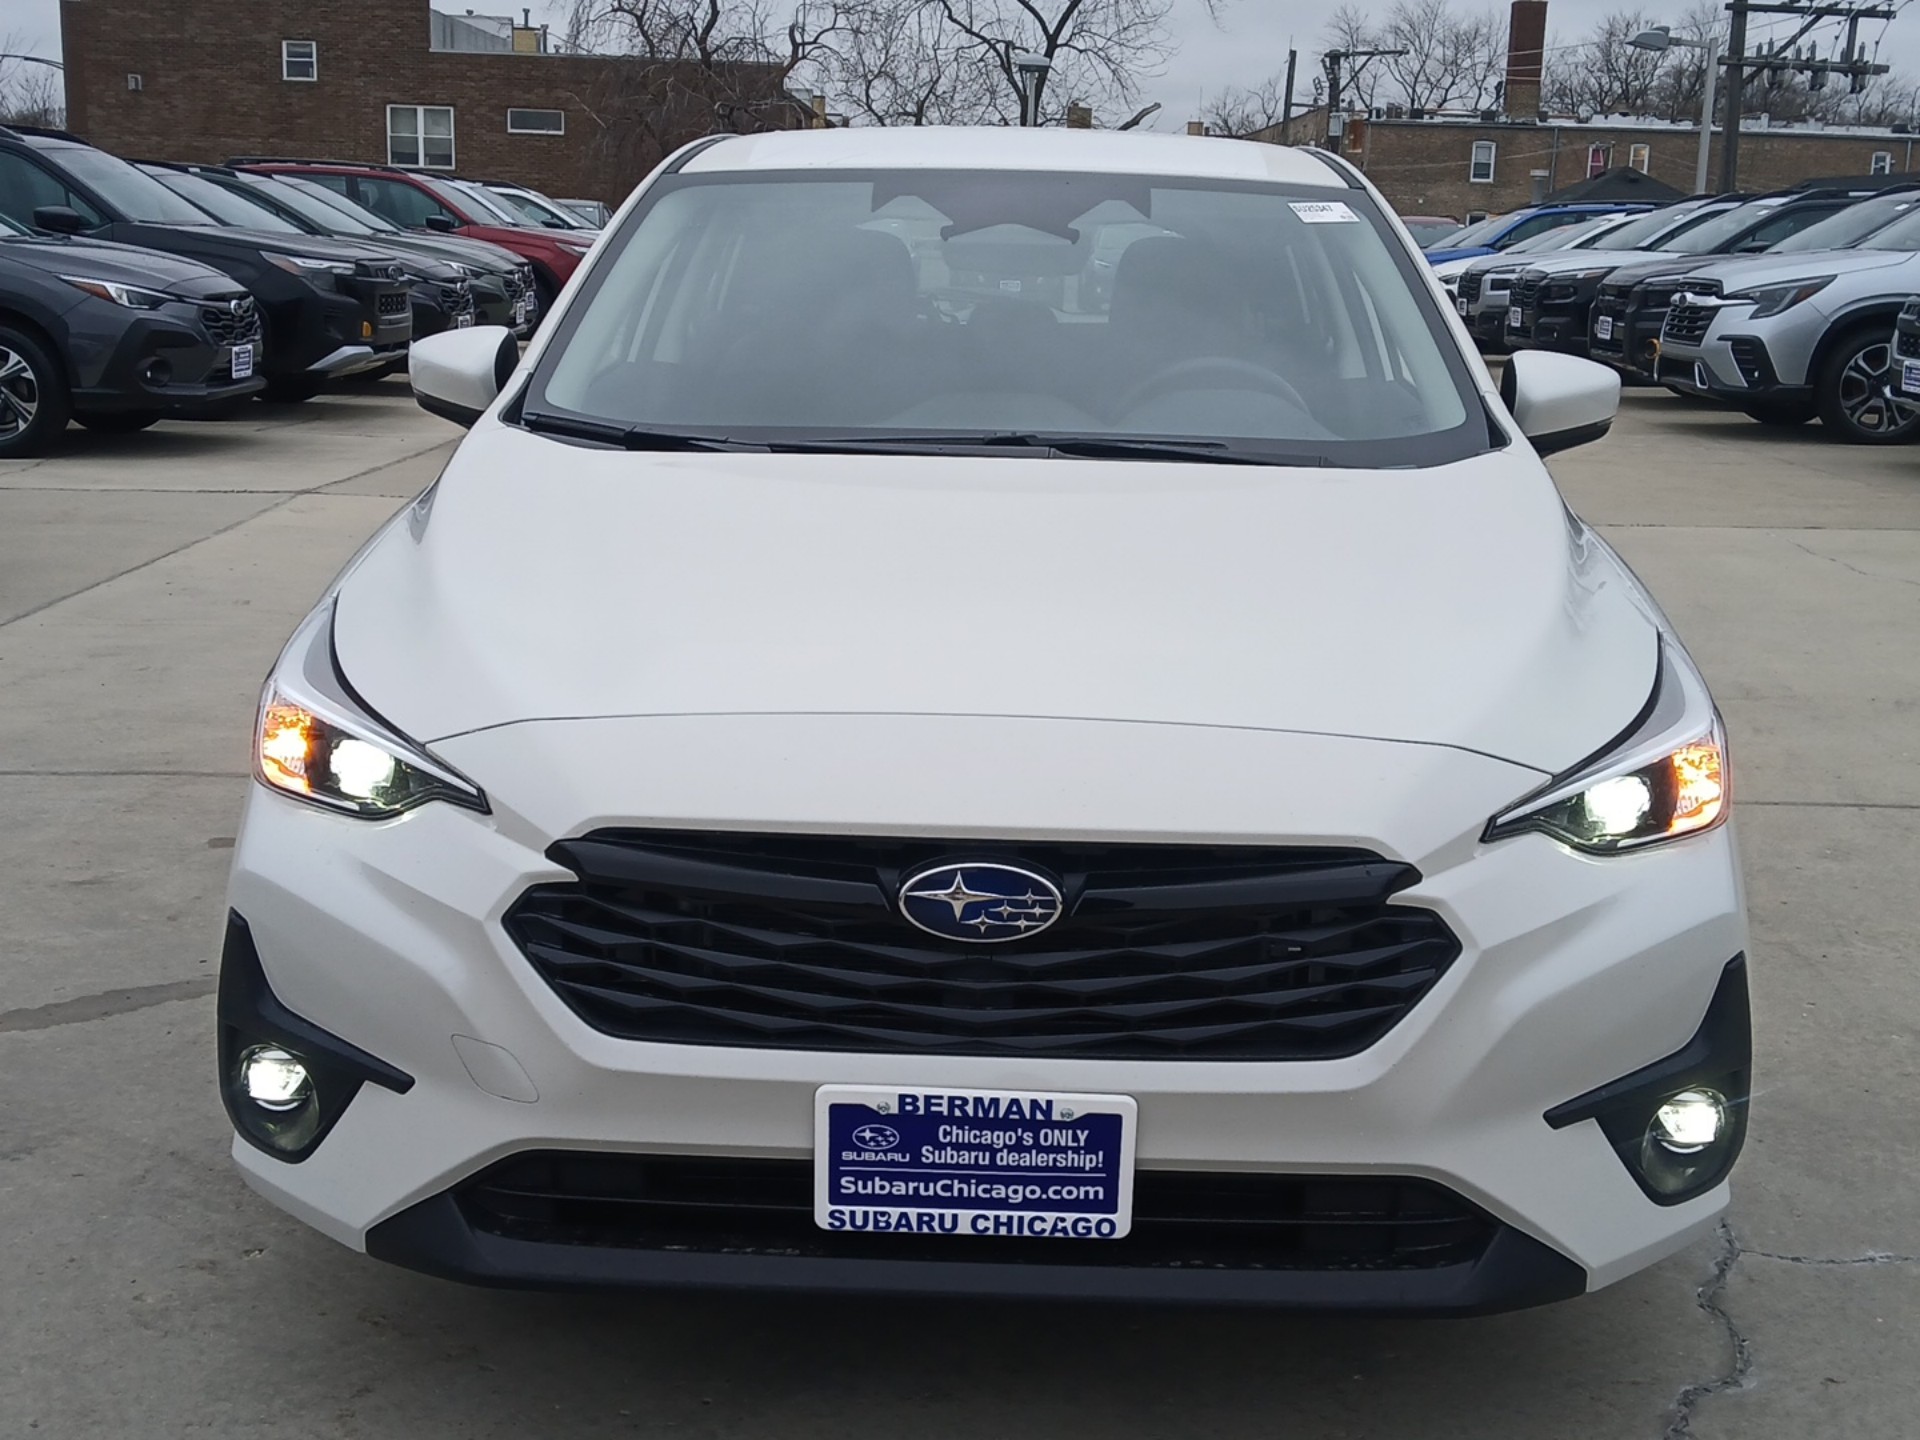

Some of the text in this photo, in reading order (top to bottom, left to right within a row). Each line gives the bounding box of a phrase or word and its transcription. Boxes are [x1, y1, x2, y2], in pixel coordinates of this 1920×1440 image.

[898, 1093, 1053, 1120] BERMAN
[938, 1125, 1089, 1147] Chicago's ONLY
[841, 1151, 910, 1162] SUBARU
[921, 1146, 1104, 1170] Subaru dealership!
[840, 1176, 1104, 1203] SubaruChicago.com
[827, 1208, 1117, 1237] SUBARU CHICAGO
